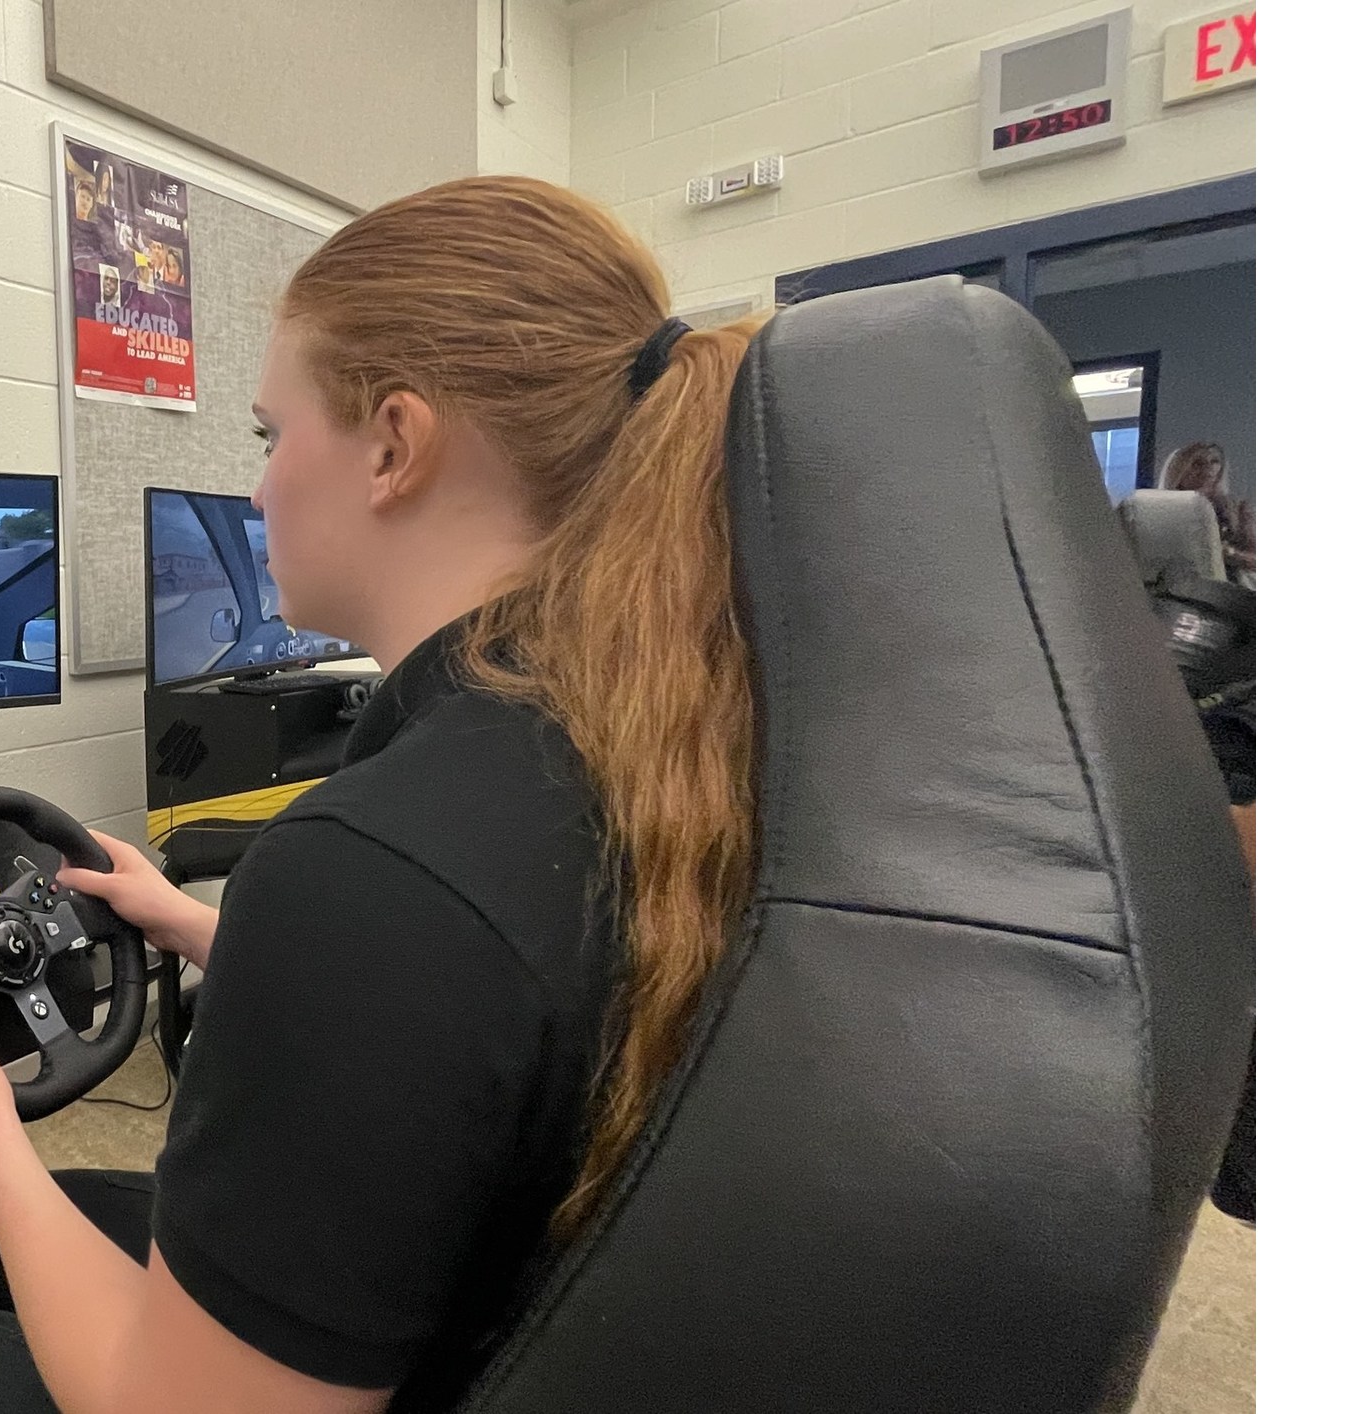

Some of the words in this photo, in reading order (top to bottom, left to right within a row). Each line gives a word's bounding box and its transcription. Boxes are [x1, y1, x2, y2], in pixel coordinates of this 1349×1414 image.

[1194, 10, 1256, 82] EX
[1006, 104, 1104, 146] 12:50
[95, 302, 178, 337] EDUCATED
[111, 326, 127, 337] AND
[127, 327, 190, 357] SKILLED
[127, 347, 135, 357] TO
[136, 349, 156, 360] LEAD
[157, 353, 186, 366] AMERICA
